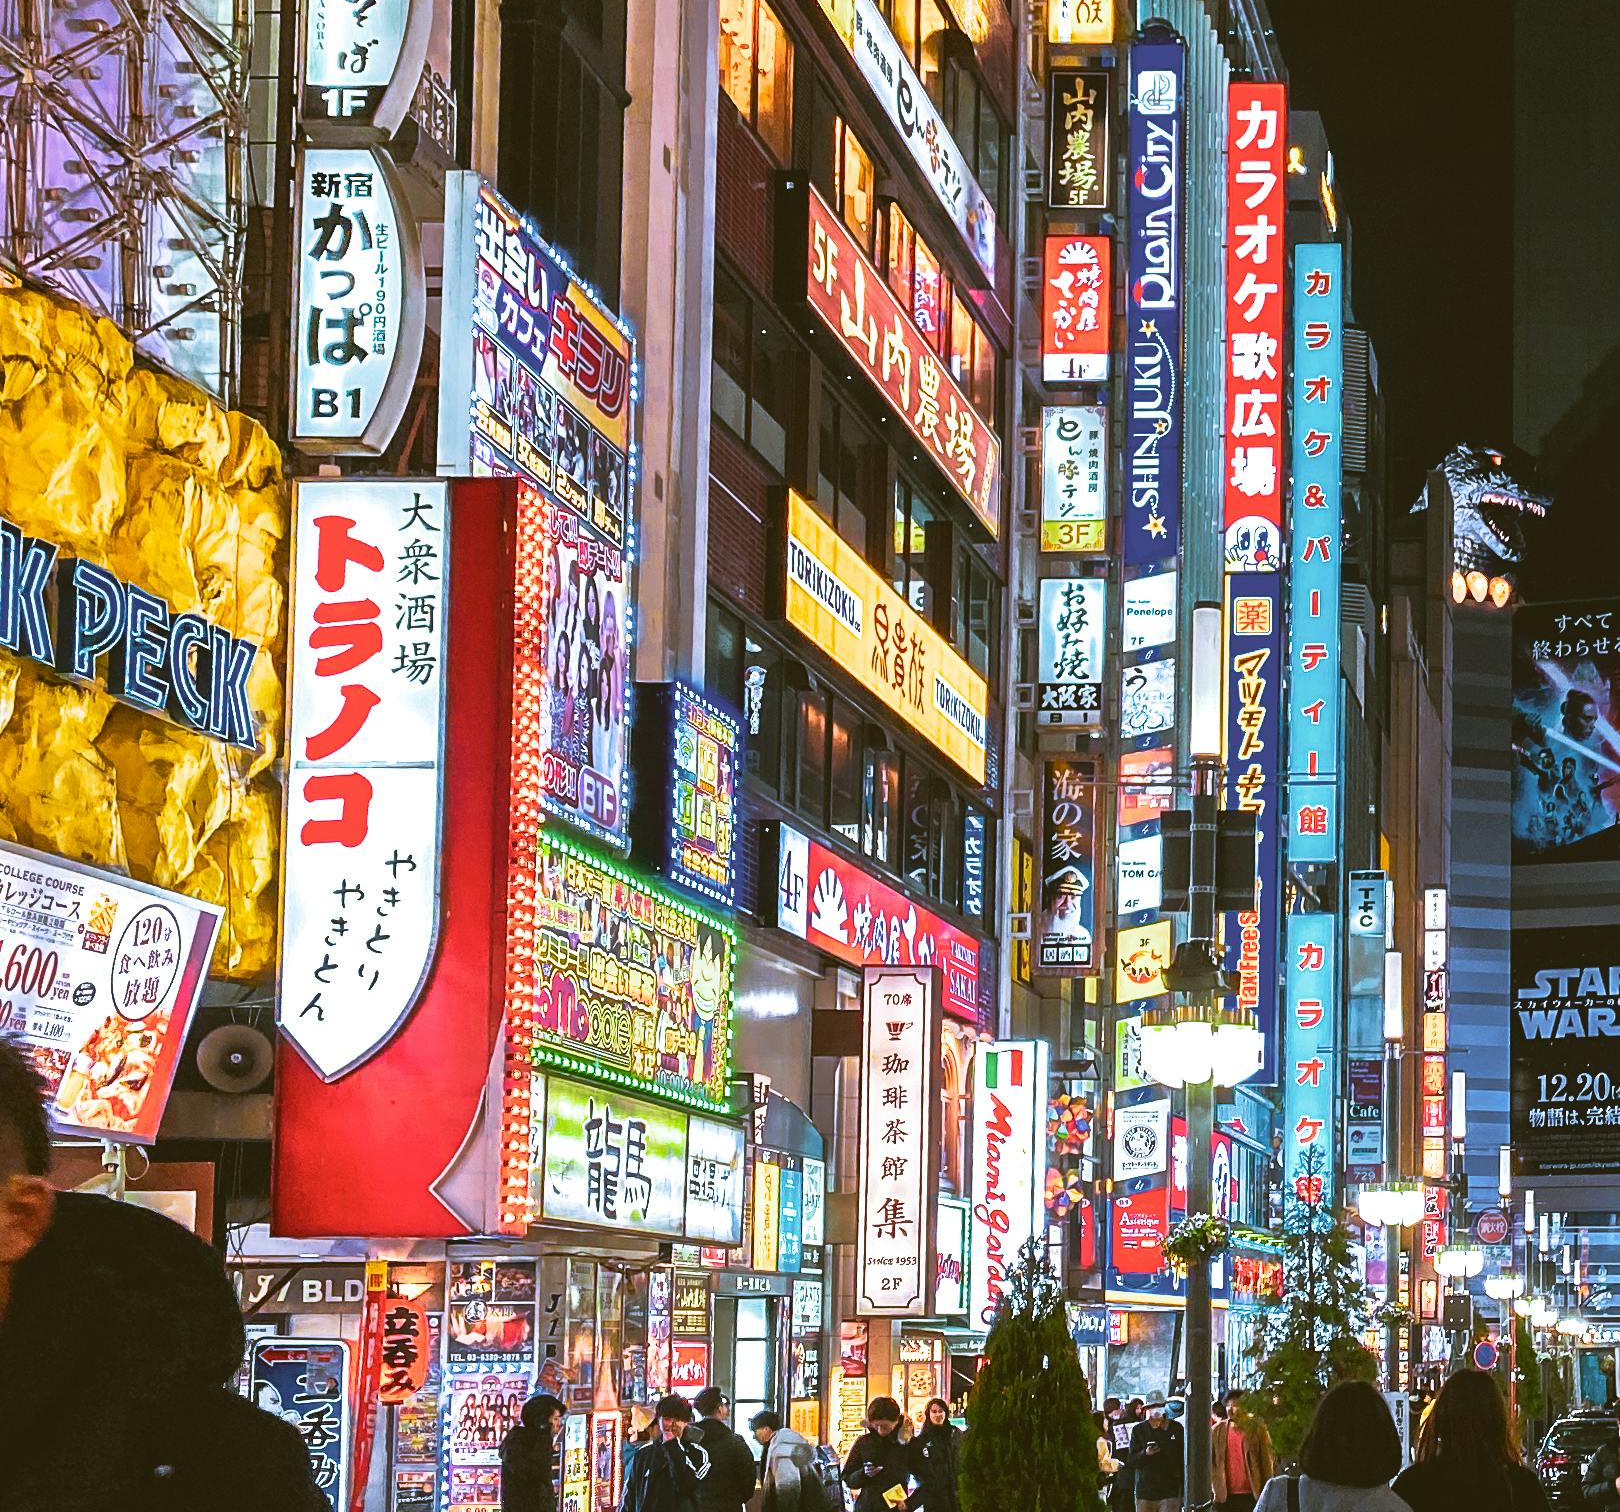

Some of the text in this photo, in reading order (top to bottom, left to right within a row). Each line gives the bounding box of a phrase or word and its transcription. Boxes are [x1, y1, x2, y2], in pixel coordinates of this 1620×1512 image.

[322, 88, 367, 117] 1F
[1058, 77, 1098, 190] 山内農場
[312, 173, 372, 198] 新宿
[1138, 121, 1176, 194] City
[1068, 190, 1089, 205] 5F
[307, 204, 373, 366] かっぱ
[480, 206, 547, 311] 出会い
[812, 220, 838, 298] 5F
[501, 292, 546, 360] カフェ
[1050, 271, 1079, 349] さかい
[1076, 263, 1103, 333] 焼肉屋
[1230, 100, 1279, 497] カラオケ歌広場
[551, 296, 626, 413] キラリ
[839, 264, 978, 496] 山内農場
[311, 388, 363, 418] B1
[1132, 341, 1173, 509] SHINJUKU
[1058, 524, 1090, 545] 3F
[1297, 268, 1333, 835] カラオケ&パーティー館
[391, 493, 440, 685] 大衆酒場
[789, 541, 856, 628] TORIKIZOKU
[1126, 607, 1173, 617] Penelope
[1238, 602, 1269, 633] 薬
[73, 557, 257, 750] PECK
[1054, 581, 1090, 681] お好み焼
[1130, 636, 1145, 646] 7F
[1554, 612, 1613, 630] すべて
[300, 515, 384, 847] トラノコ
[934, 677, 981, 741] TORIKIZOKU
[1041, 685, 1098, 709] 大阪家
[583, 773, 615, 821] B1F
[1051, 768, 1085, 862] 海の家
[45, 877, 84, 896] COURSE
[780, 849, 804, 916] 4F
[1125, 898, 1140, 908] 4F
[300, 882, 365, 1020] やきとん
[356, 851, 417, 990] やきとり
[1139, 938, 1150, 948] 3F
[124, 977, 159, 1007] 放題
[884, 994, 912, 1006] 70席
[950, 968, 975, 1004] SAKAI
[1350, 1103, 1379, 1118] Cafe
[873, 1054, 914, 1239] 珈琲茶館 集
[868, 1256, 917, 1266] SINCE 1953
[882, 1278, 902, 1290] 2F
[379, 1306, 420, 1394] 立呑み
